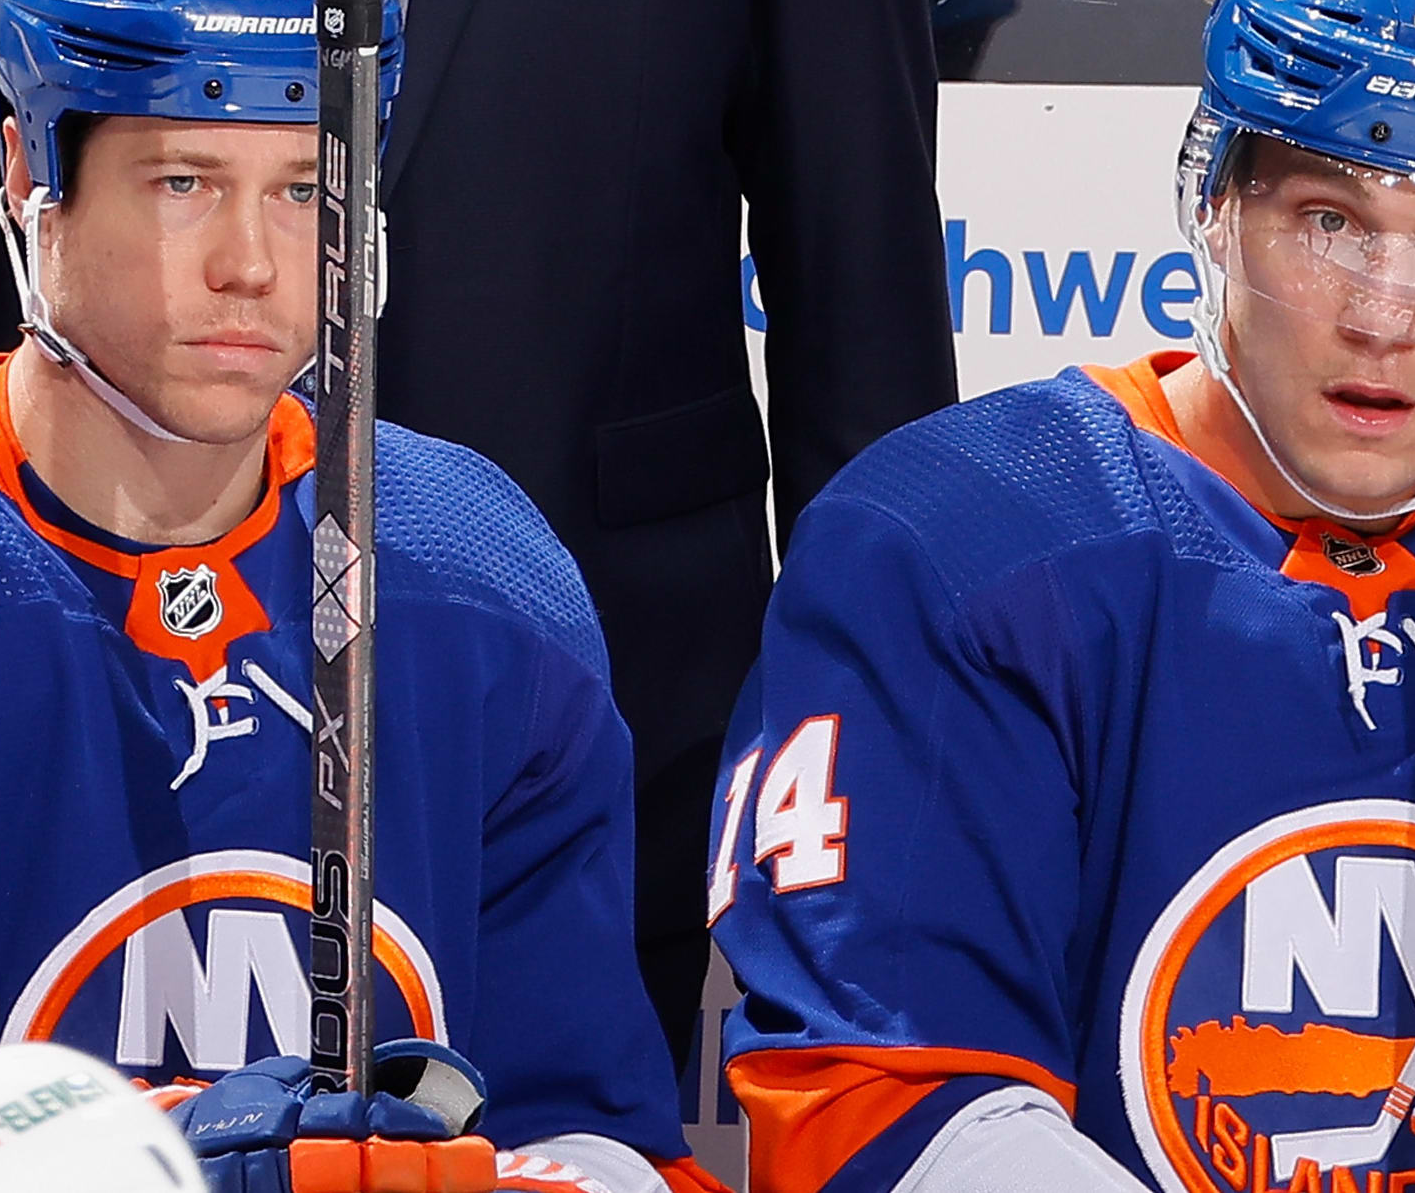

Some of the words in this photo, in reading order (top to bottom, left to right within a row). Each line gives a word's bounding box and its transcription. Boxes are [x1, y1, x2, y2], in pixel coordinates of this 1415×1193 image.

[186, 6, 318, 35] WARRIOR
[322, 130, 347, 396] TRUE
[363, 162, 376, 319] TRUE
[707, 713, 850, 928] 14
[114, 908, 313, 1071] N
